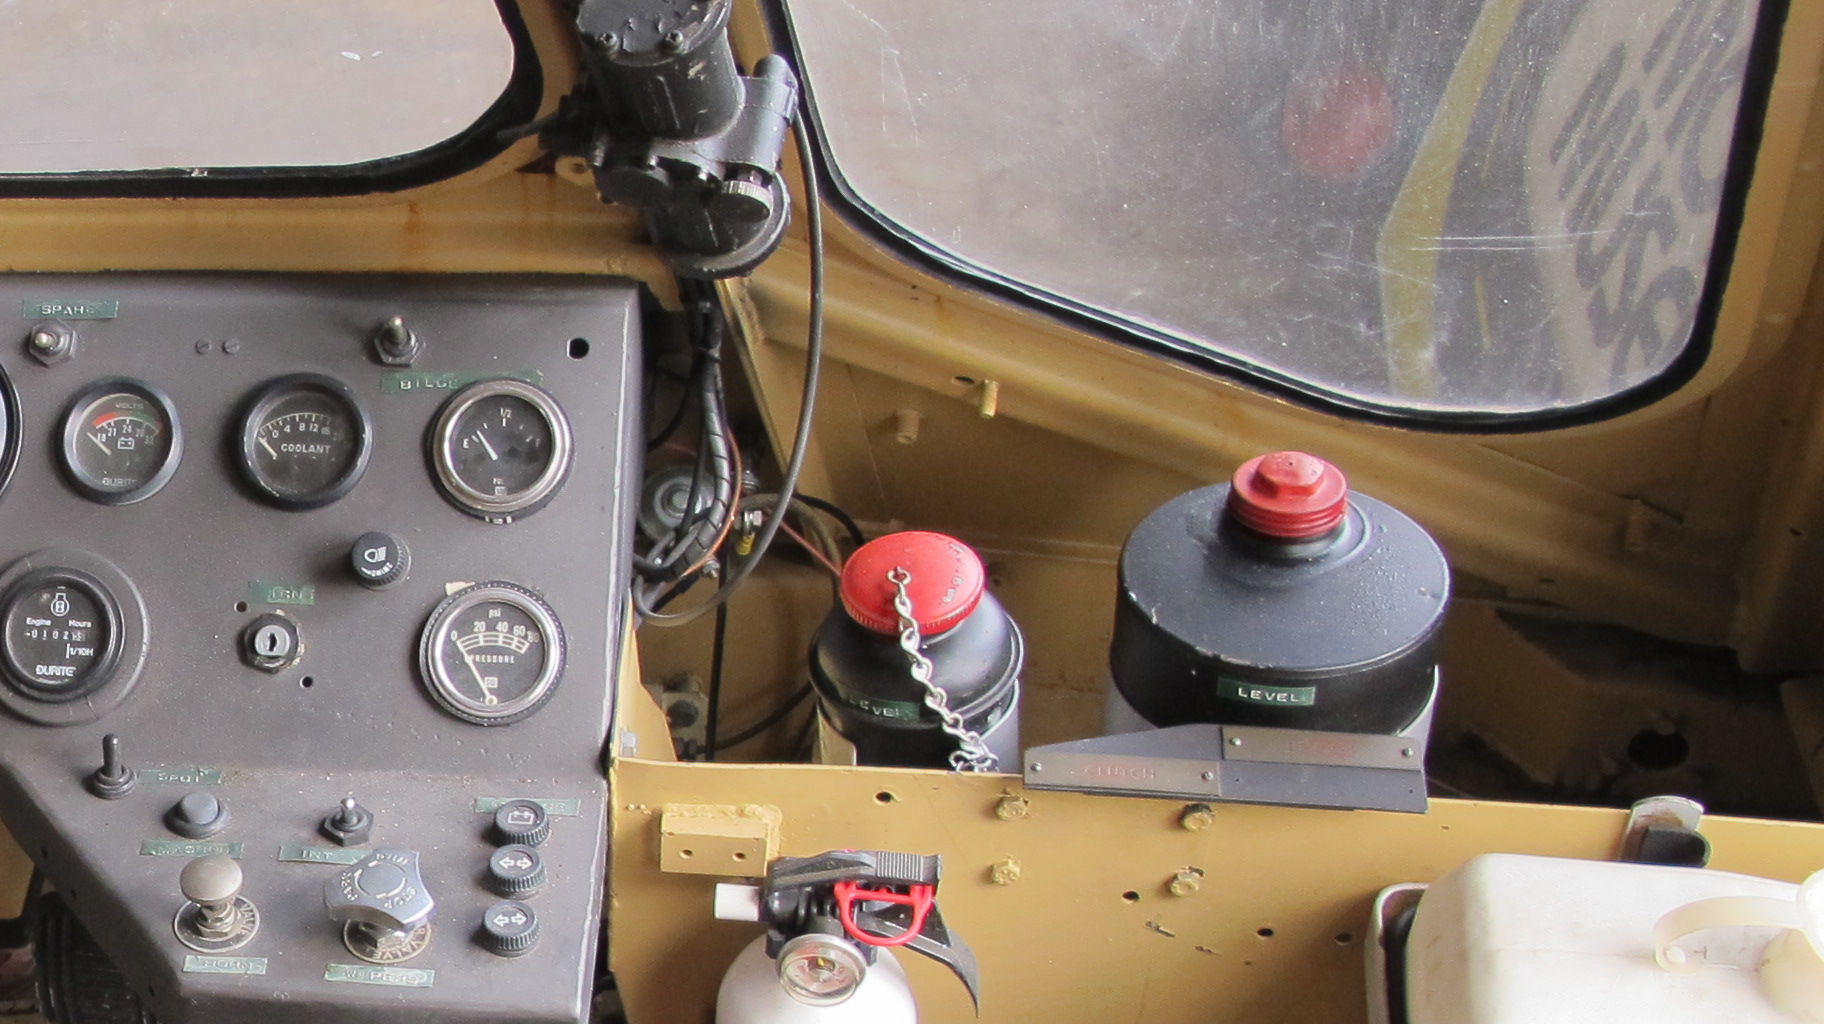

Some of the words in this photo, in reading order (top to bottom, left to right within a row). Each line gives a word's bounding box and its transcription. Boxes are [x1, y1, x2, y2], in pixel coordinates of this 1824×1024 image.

[122, 425, 132, 434] 24
[284, 425, 291, 433] 4
[299, 423, 306, 431] 8
[272, 430, 279, 438] 0
[280, 443, 331, 454] COOLANT
[463, 439, 469, 449] E
[488, 608, 501, 618] psi
[26, 617, 51, 627] Engine
[68, 619, 92, 628] Hours
[473, 621, 485, 632] 20
[496, 622, 509, 632] 40
[451, 630, 457, 641] 0
[514, 626, 525, 636] 60
[470, 655, 515, 664] PRESSURE
[1238, 687, 1300, 702] LEVEL
